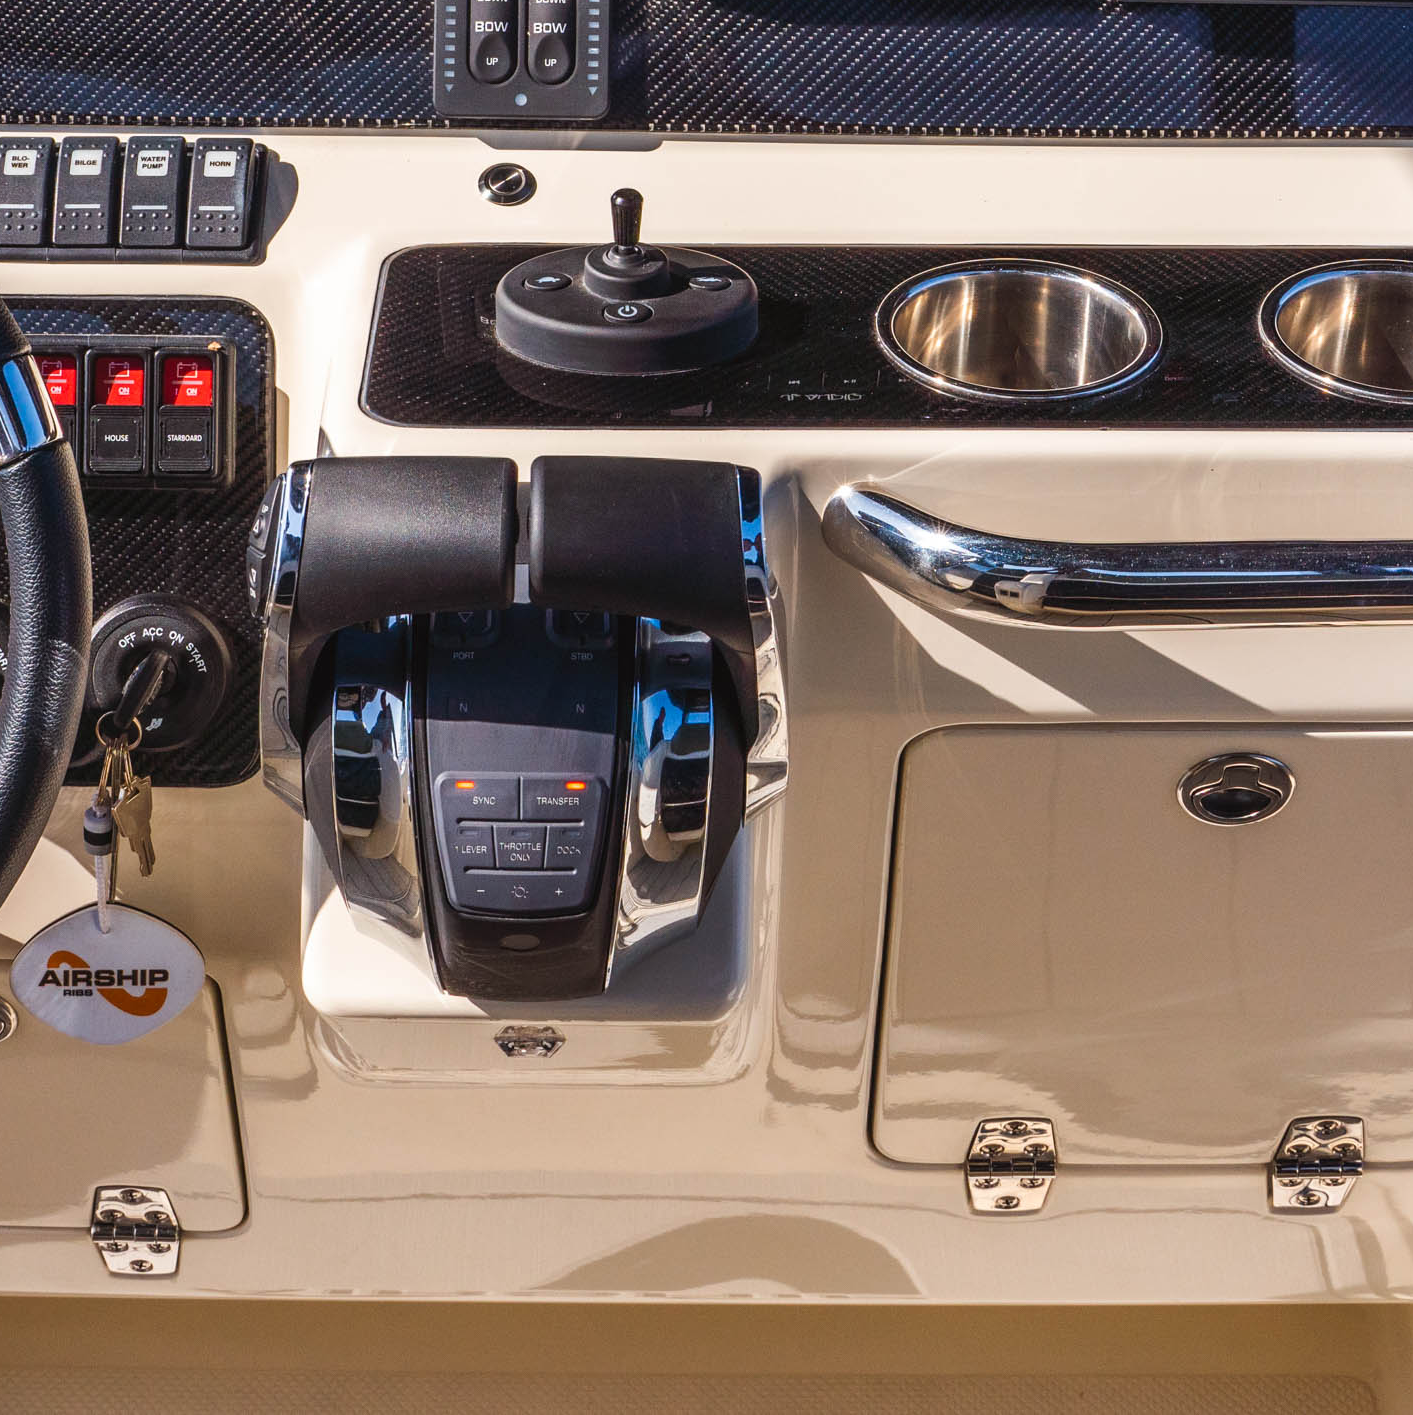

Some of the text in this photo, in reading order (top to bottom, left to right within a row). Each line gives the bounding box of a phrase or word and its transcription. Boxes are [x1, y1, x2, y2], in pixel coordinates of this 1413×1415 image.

[475, 21, 508, 33] BOW
[533, 23, 568, 34] BOW
[486, 57, 499, 66] UP
[544, 59, 557, 67] UP
[74, 159, 97, 167] BILGE
[50, 385, 62, 395] ON
[118, 386, 130, 396] ON
[186, 387, 198, 397] ON
[104, 434, 129, 443] HOUSE
[167, 434, 203, 443] STARBOARD
[118, 627, 208, 674] OFF ACC ON START
[452, 651, 594, 661] PORT STBD
[458, 702, 585, 714] N N
[472, 796, 579, 806] SYNC TRANSFER
[462, 845, 487, 854] LEVER
[499, 842, 542, 851] THROTTLE
[509, 853, 531, 862] ONLY
[38, 969, 169, 987] AIRSHIP
